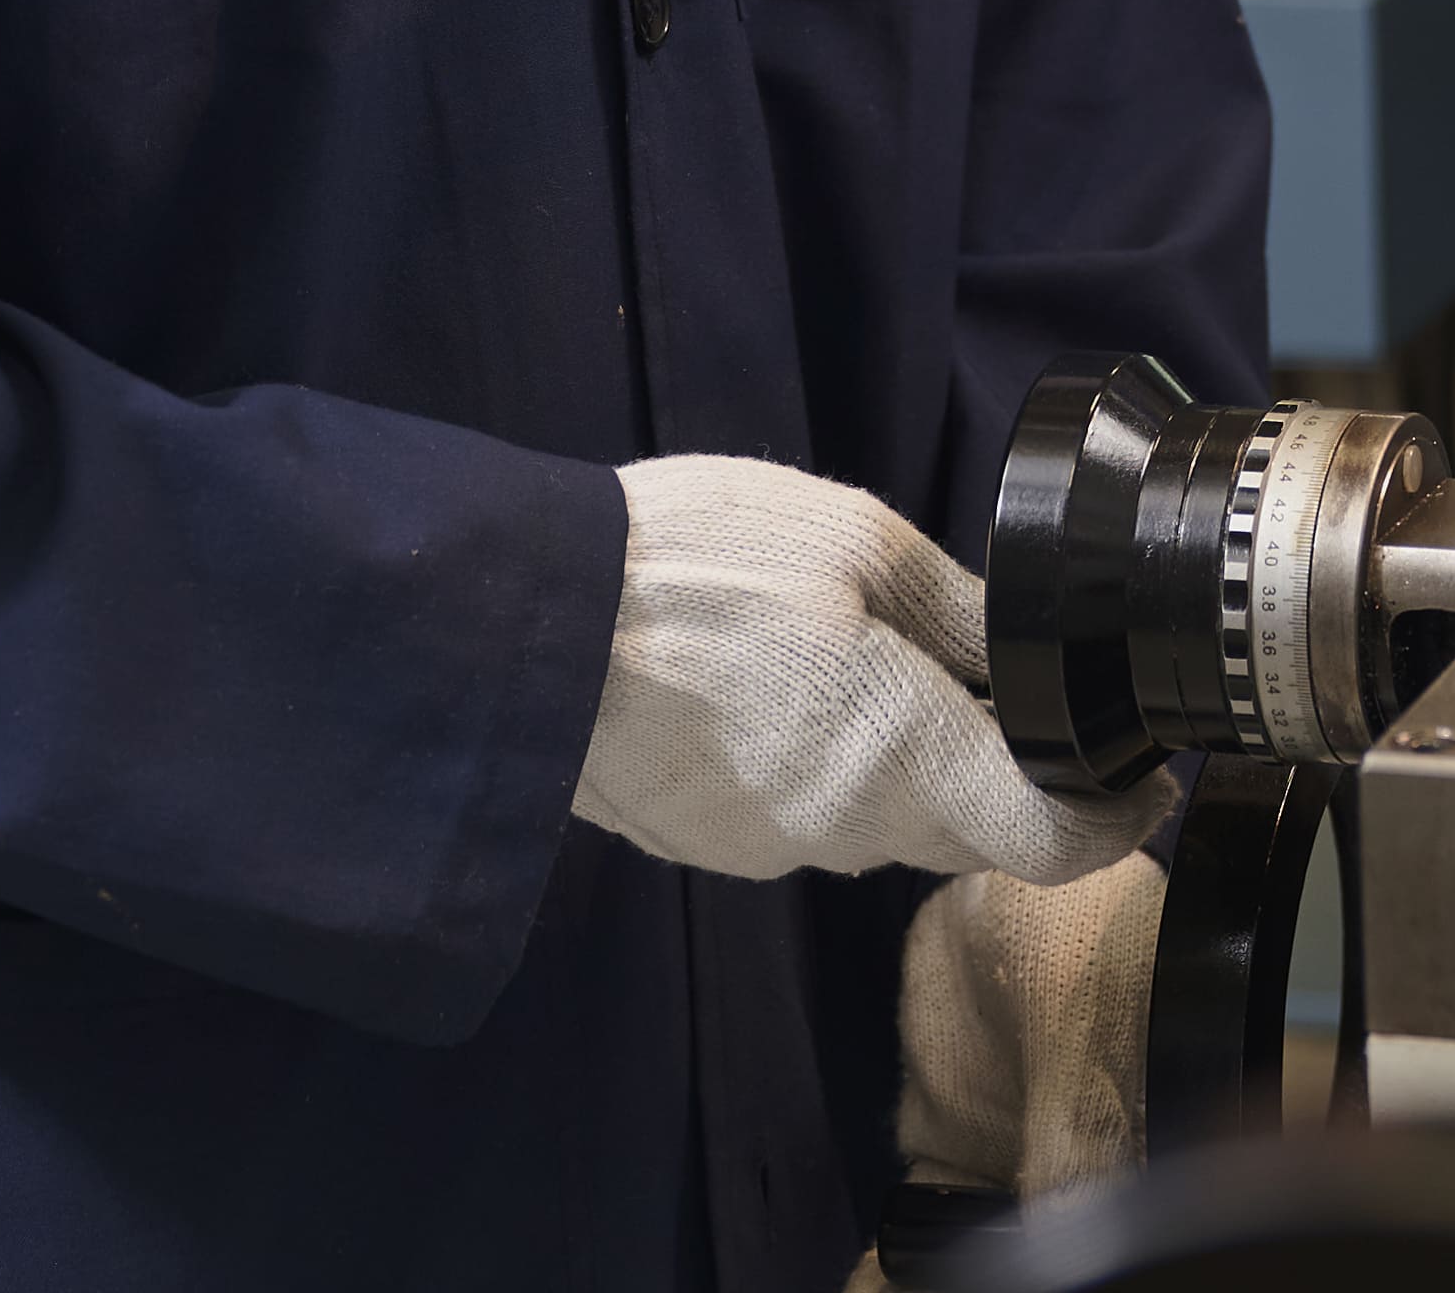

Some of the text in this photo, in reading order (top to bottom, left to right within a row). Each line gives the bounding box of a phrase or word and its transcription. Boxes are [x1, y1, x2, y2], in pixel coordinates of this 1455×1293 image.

[1290, 433, 1308, 451] 4.6
[1280, 461, 1296, 482] 4.4
[1270, 498, 1287, 523] 4.2
[1264, 540, 1280, 567] 4.0
[1261, 586, 1277, 612] 3.8
[1262, 631, 1277, 656] 3.6
[1265, 673, 1281, 695] 3.4
[1271, 708, 1289, 728] 3.2
